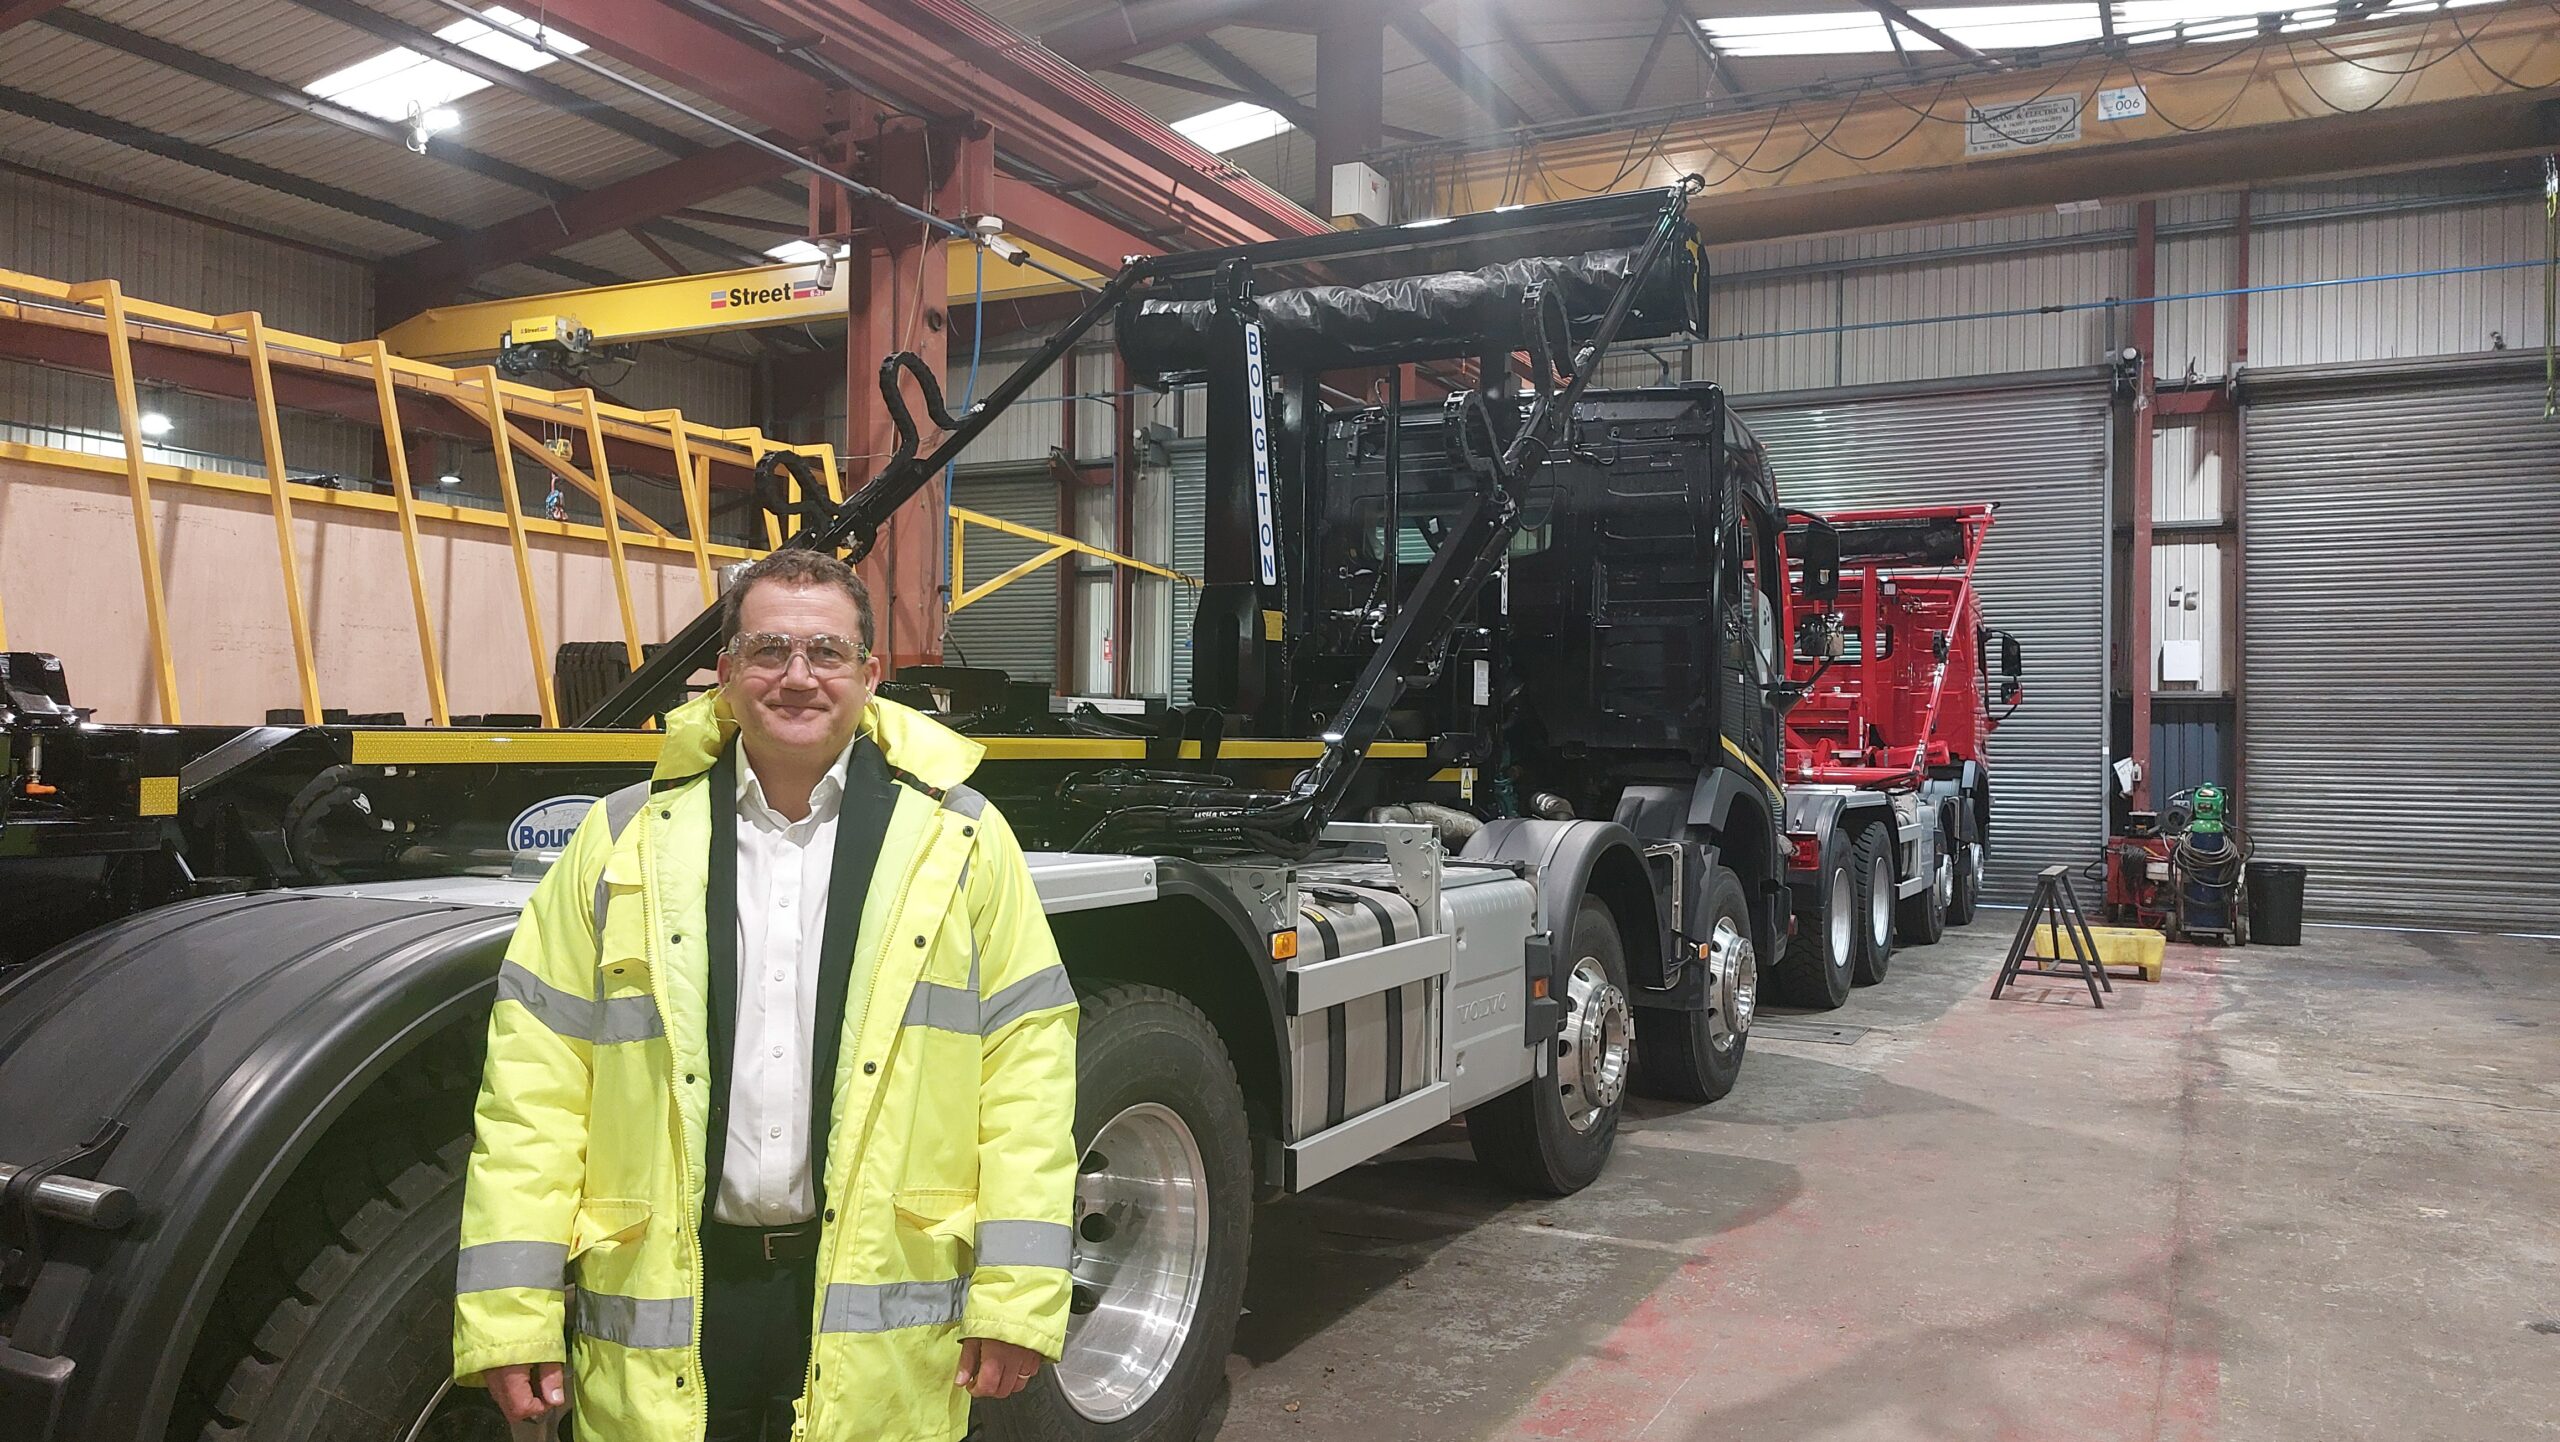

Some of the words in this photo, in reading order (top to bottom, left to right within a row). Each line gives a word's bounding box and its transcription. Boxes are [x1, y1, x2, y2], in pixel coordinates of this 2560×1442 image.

[2115, 98, 2141, 111] 006
[730, 282, 791, 307] Street
[1248, 331, 1274, 579] BOUGHTON
[1457, 991, 1507, 1024] VOLVO
